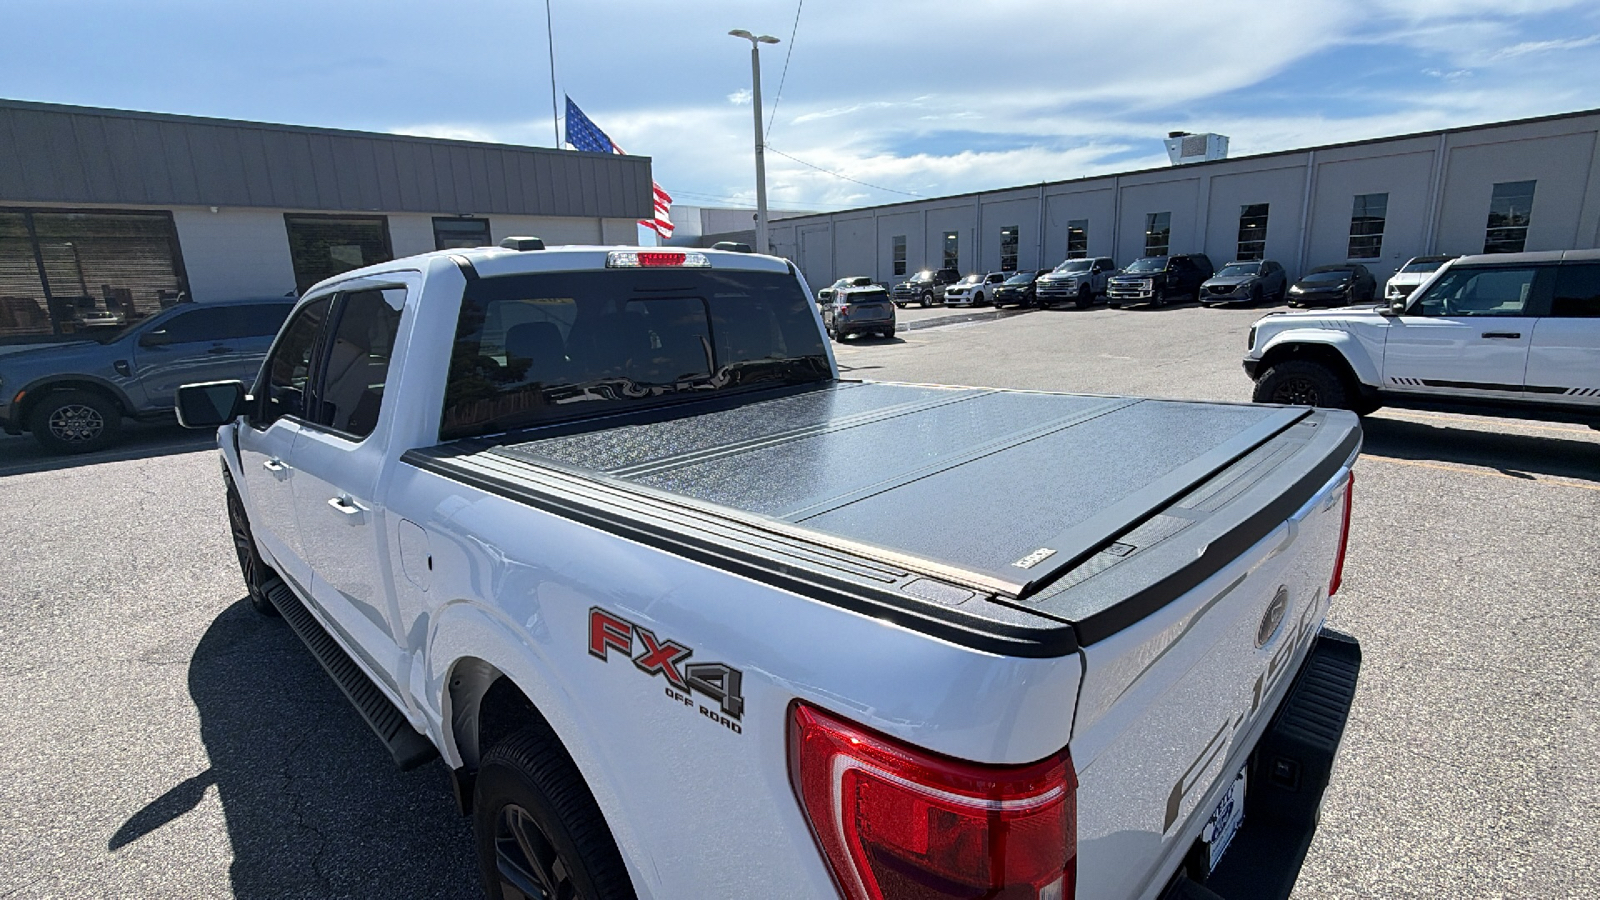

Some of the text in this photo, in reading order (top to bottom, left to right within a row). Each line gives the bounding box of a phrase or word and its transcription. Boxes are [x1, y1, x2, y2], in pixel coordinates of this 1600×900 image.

[588, 605, 745, 723] FX4
[665, 687, 743, 735] OFF ROAD
[1162, 586, 1322, 836] F-150
